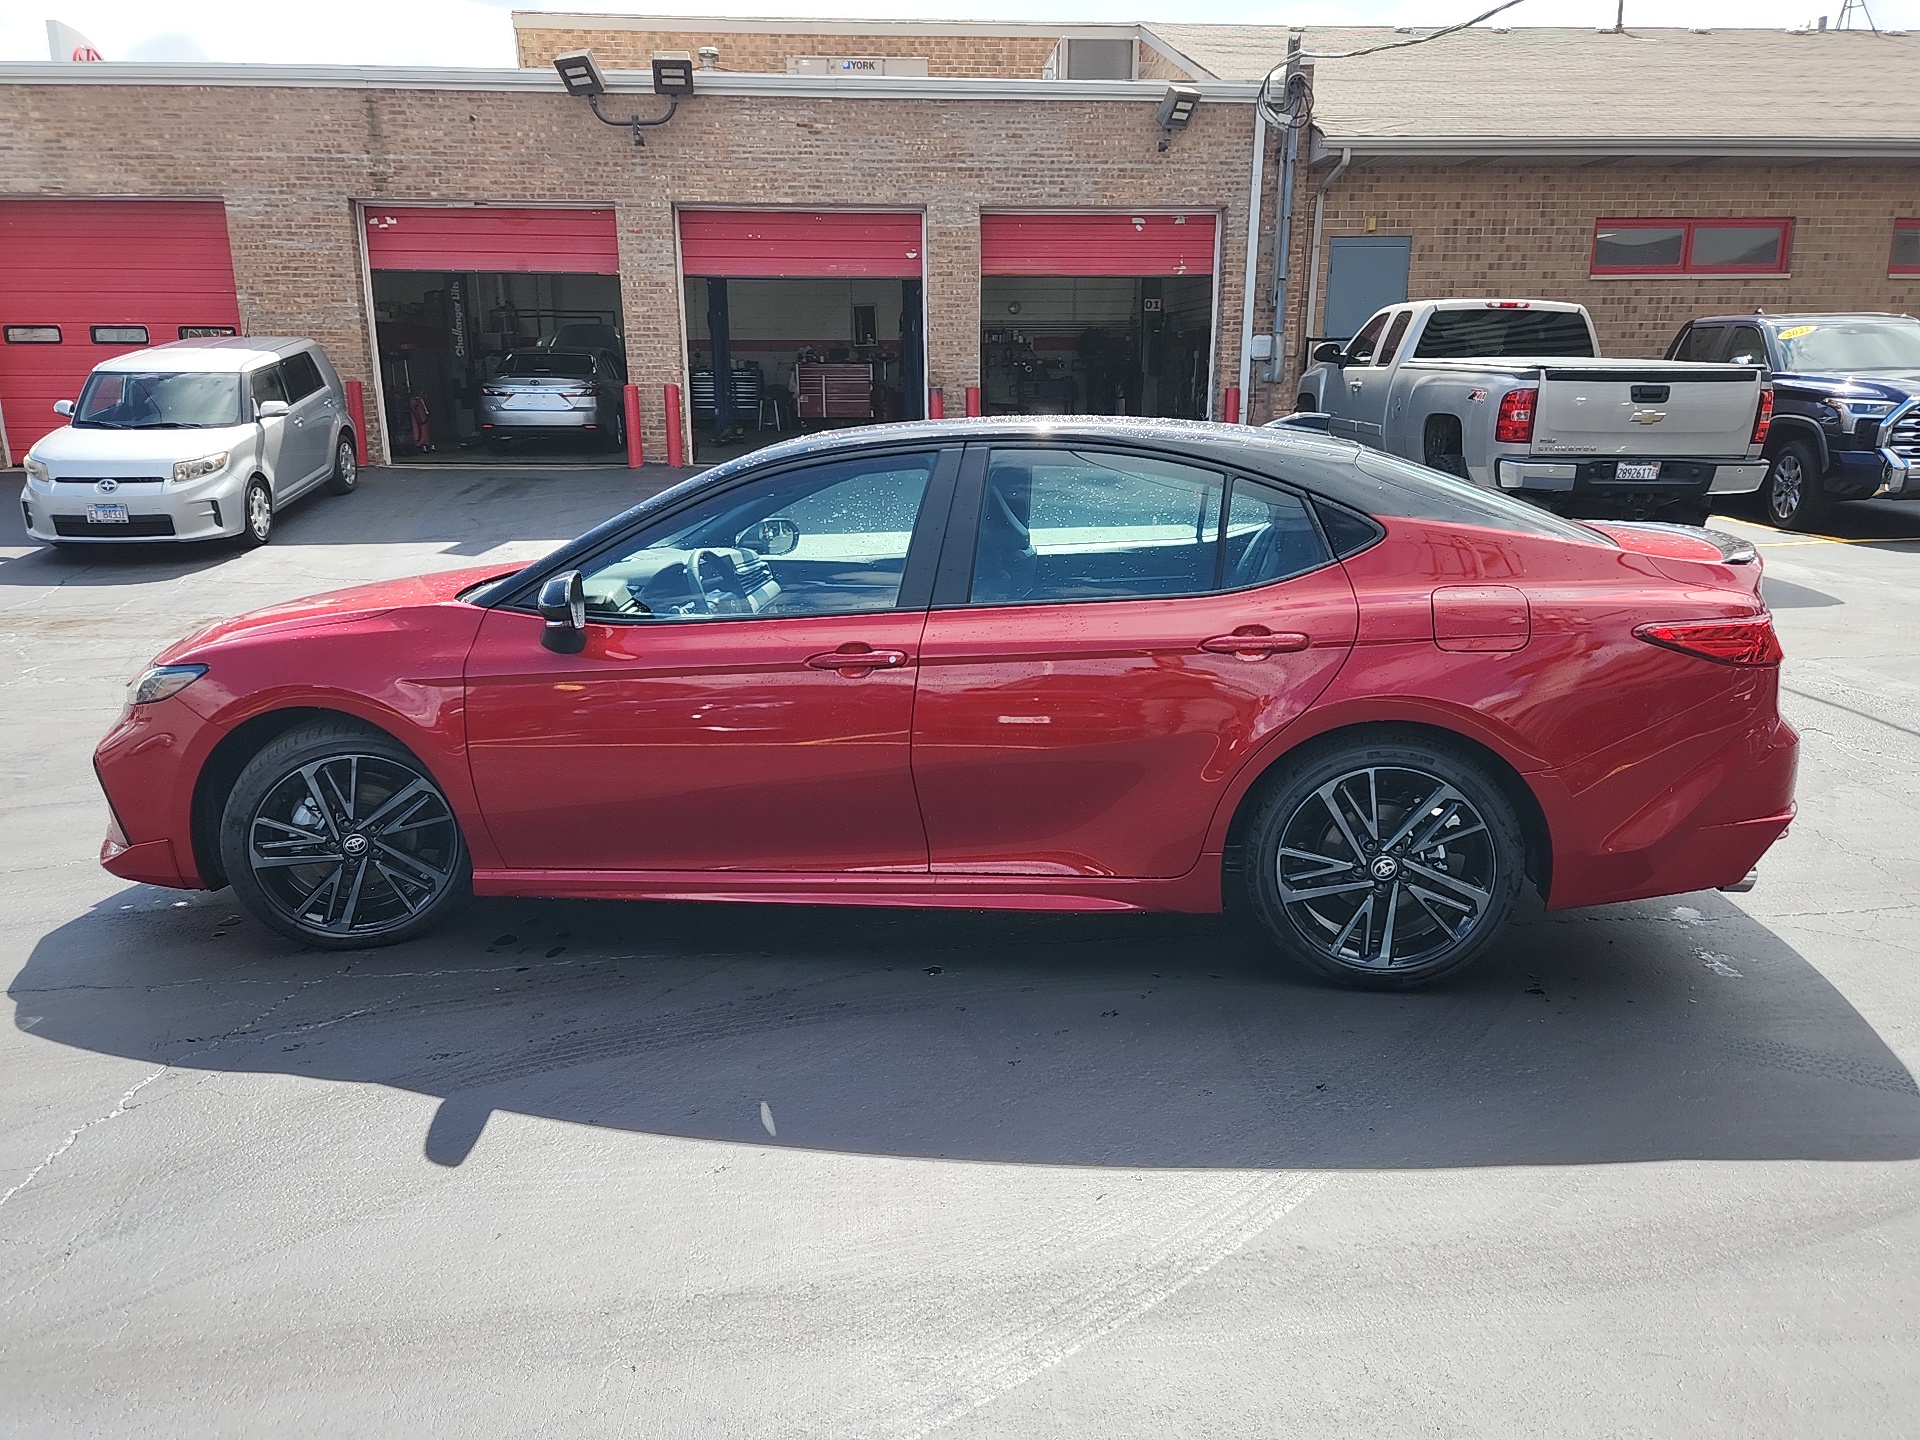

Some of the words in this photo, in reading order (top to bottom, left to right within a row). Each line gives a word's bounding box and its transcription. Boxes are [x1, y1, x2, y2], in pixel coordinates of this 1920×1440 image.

[851, 61, 875, 70] YORK
[451, 281, 460, 300] Lifts
[1145, 300, 1160, 310] 01
[452, 302, 464, 357] Challenger
[1617, 467, 1652, 478] 2892617
